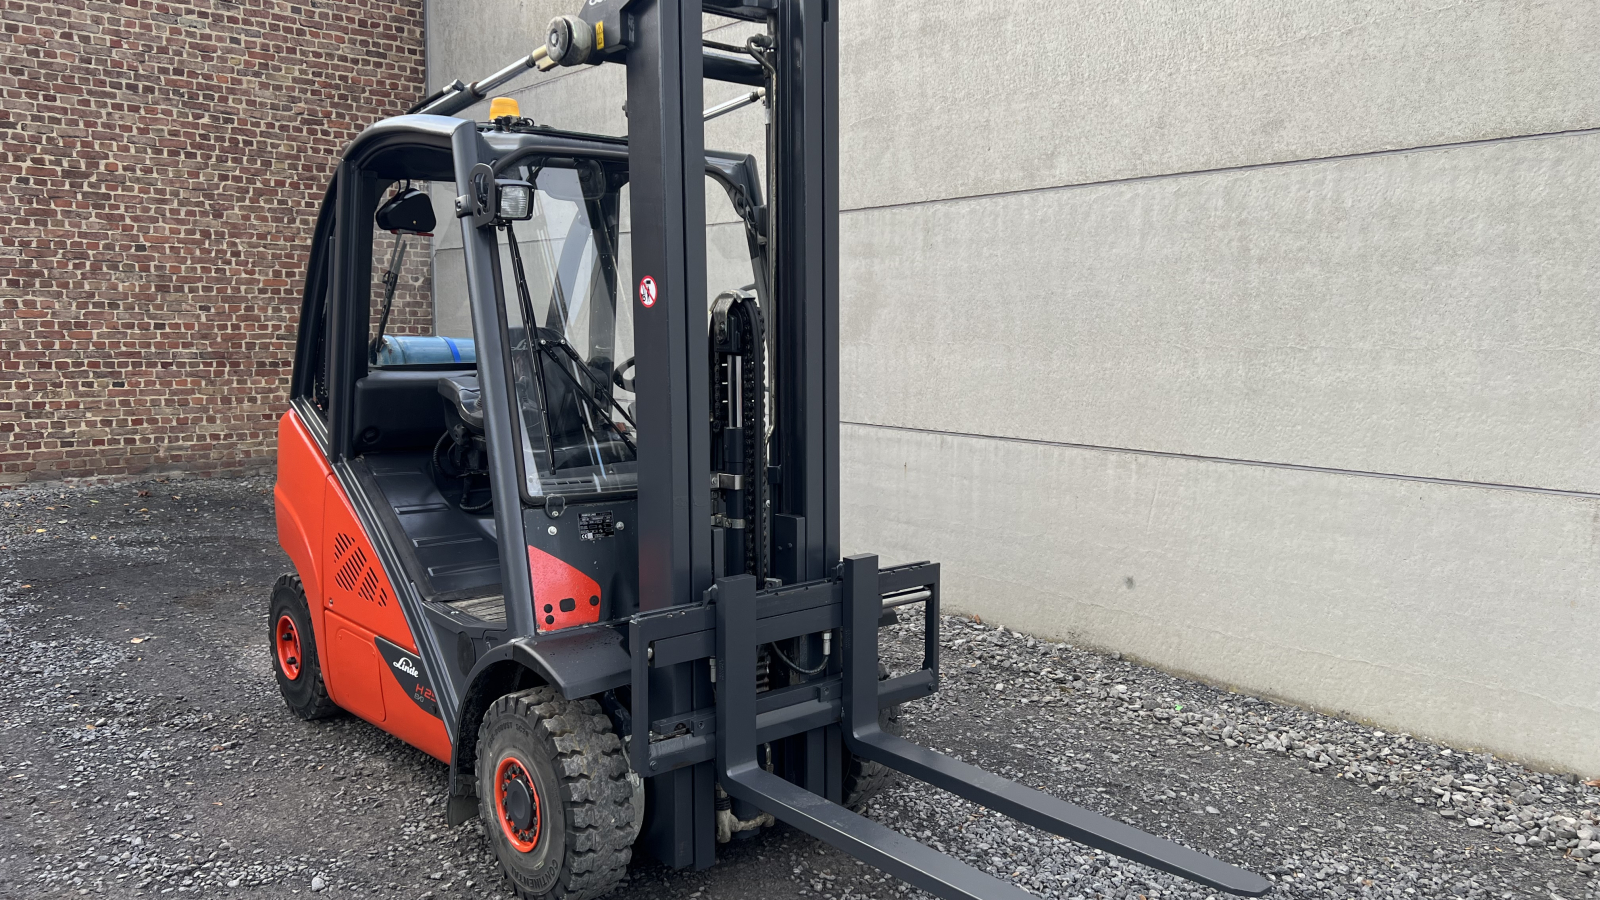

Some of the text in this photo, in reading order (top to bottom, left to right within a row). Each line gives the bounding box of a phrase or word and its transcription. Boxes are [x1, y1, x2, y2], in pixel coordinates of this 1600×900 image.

[393, 657, 418, 677] Linde
[414, 692, 424, 702] EVO
[510, 859, 559, 890] CONTINENTAL
